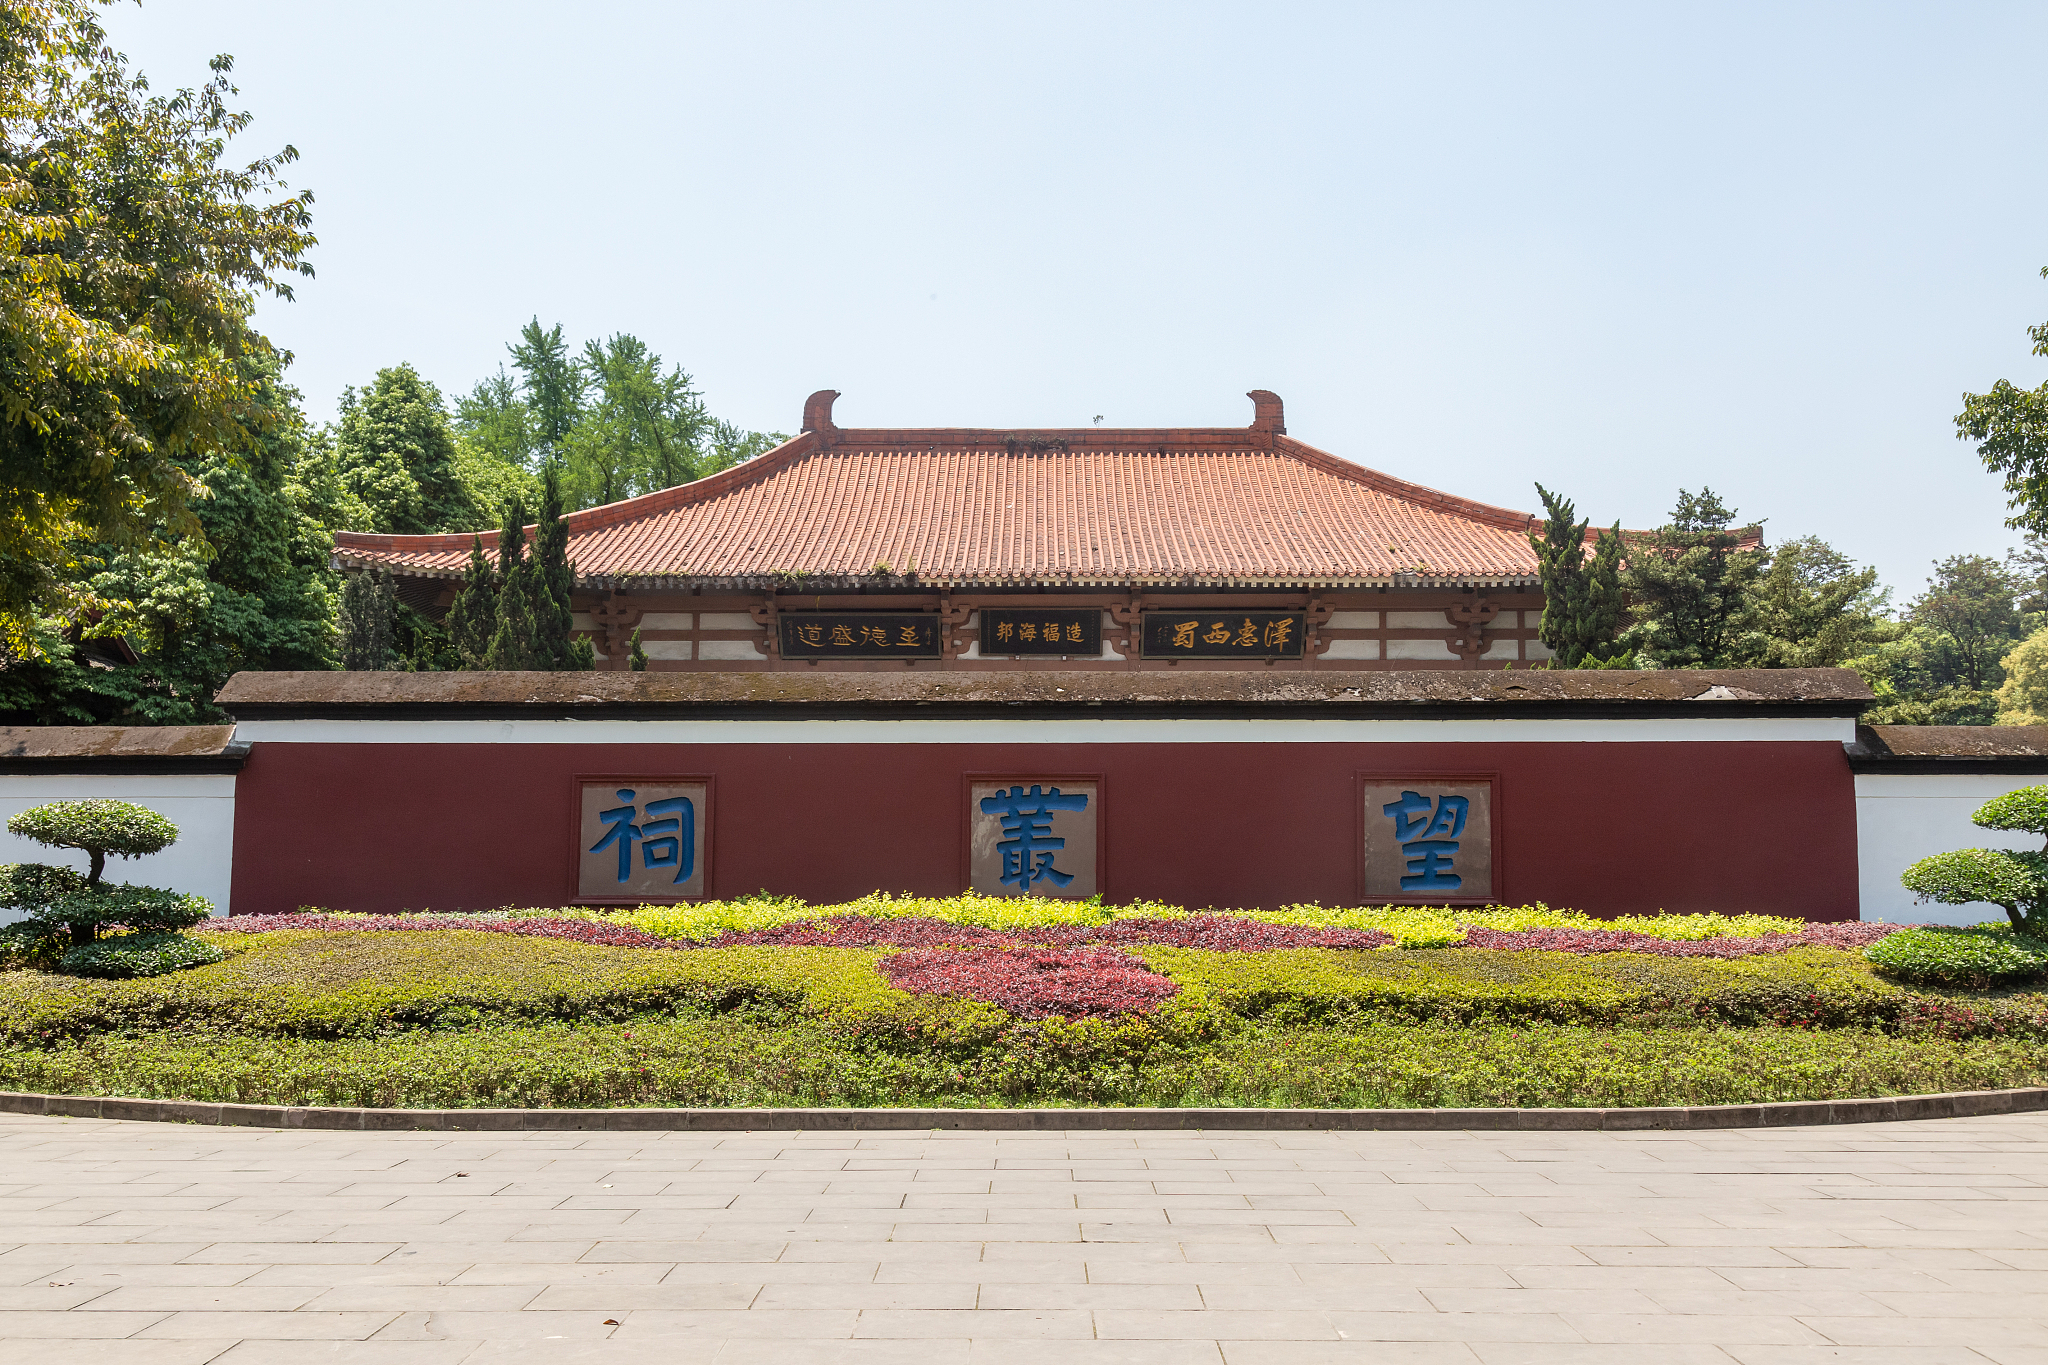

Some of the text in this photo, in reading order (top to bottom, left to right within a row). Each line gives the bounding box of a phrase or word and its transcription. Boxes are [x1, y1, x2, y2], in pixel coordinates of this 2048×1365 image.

[588, 788, 695, 885] 祠
[980, 784, 1089, 892] 叢
[1382, 790, 1470, 892] 望
